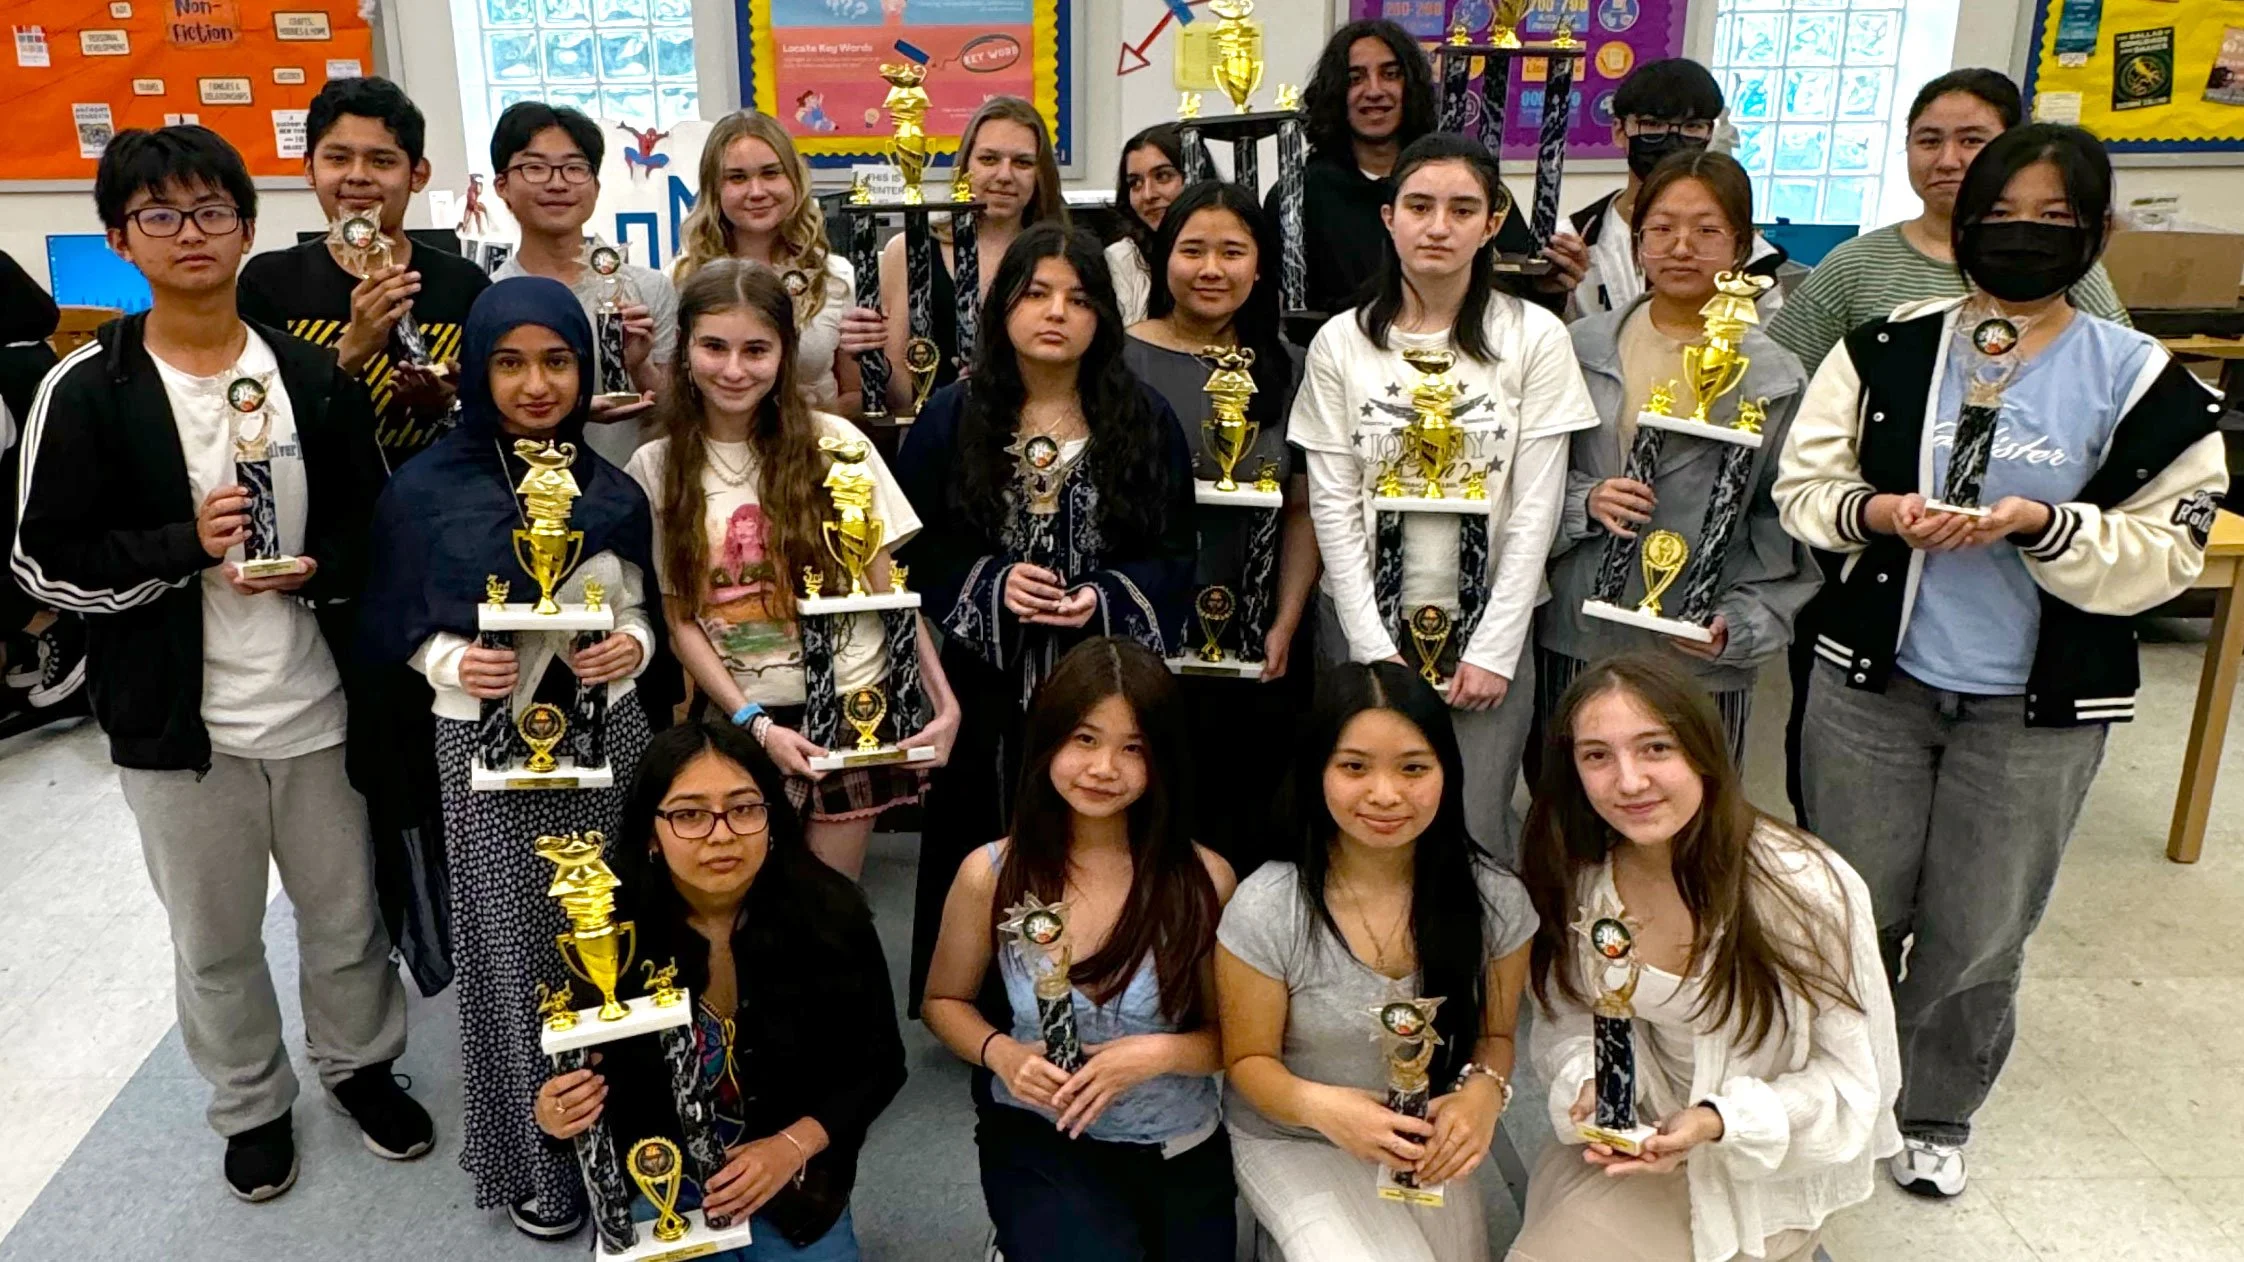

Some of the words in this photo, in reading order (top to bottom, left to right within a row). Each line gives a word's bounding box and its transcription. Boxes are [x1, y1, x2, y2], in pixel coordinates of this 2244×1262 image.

[175, 0, 221, 17] Non-
[173, 23, 233, 43] Fiction
[782, 44, 817, 52] Locate
[818, 44, 838, 54] Key
[839, 43, 873, 53] Words
[963, 52, 985, 65] KEY
